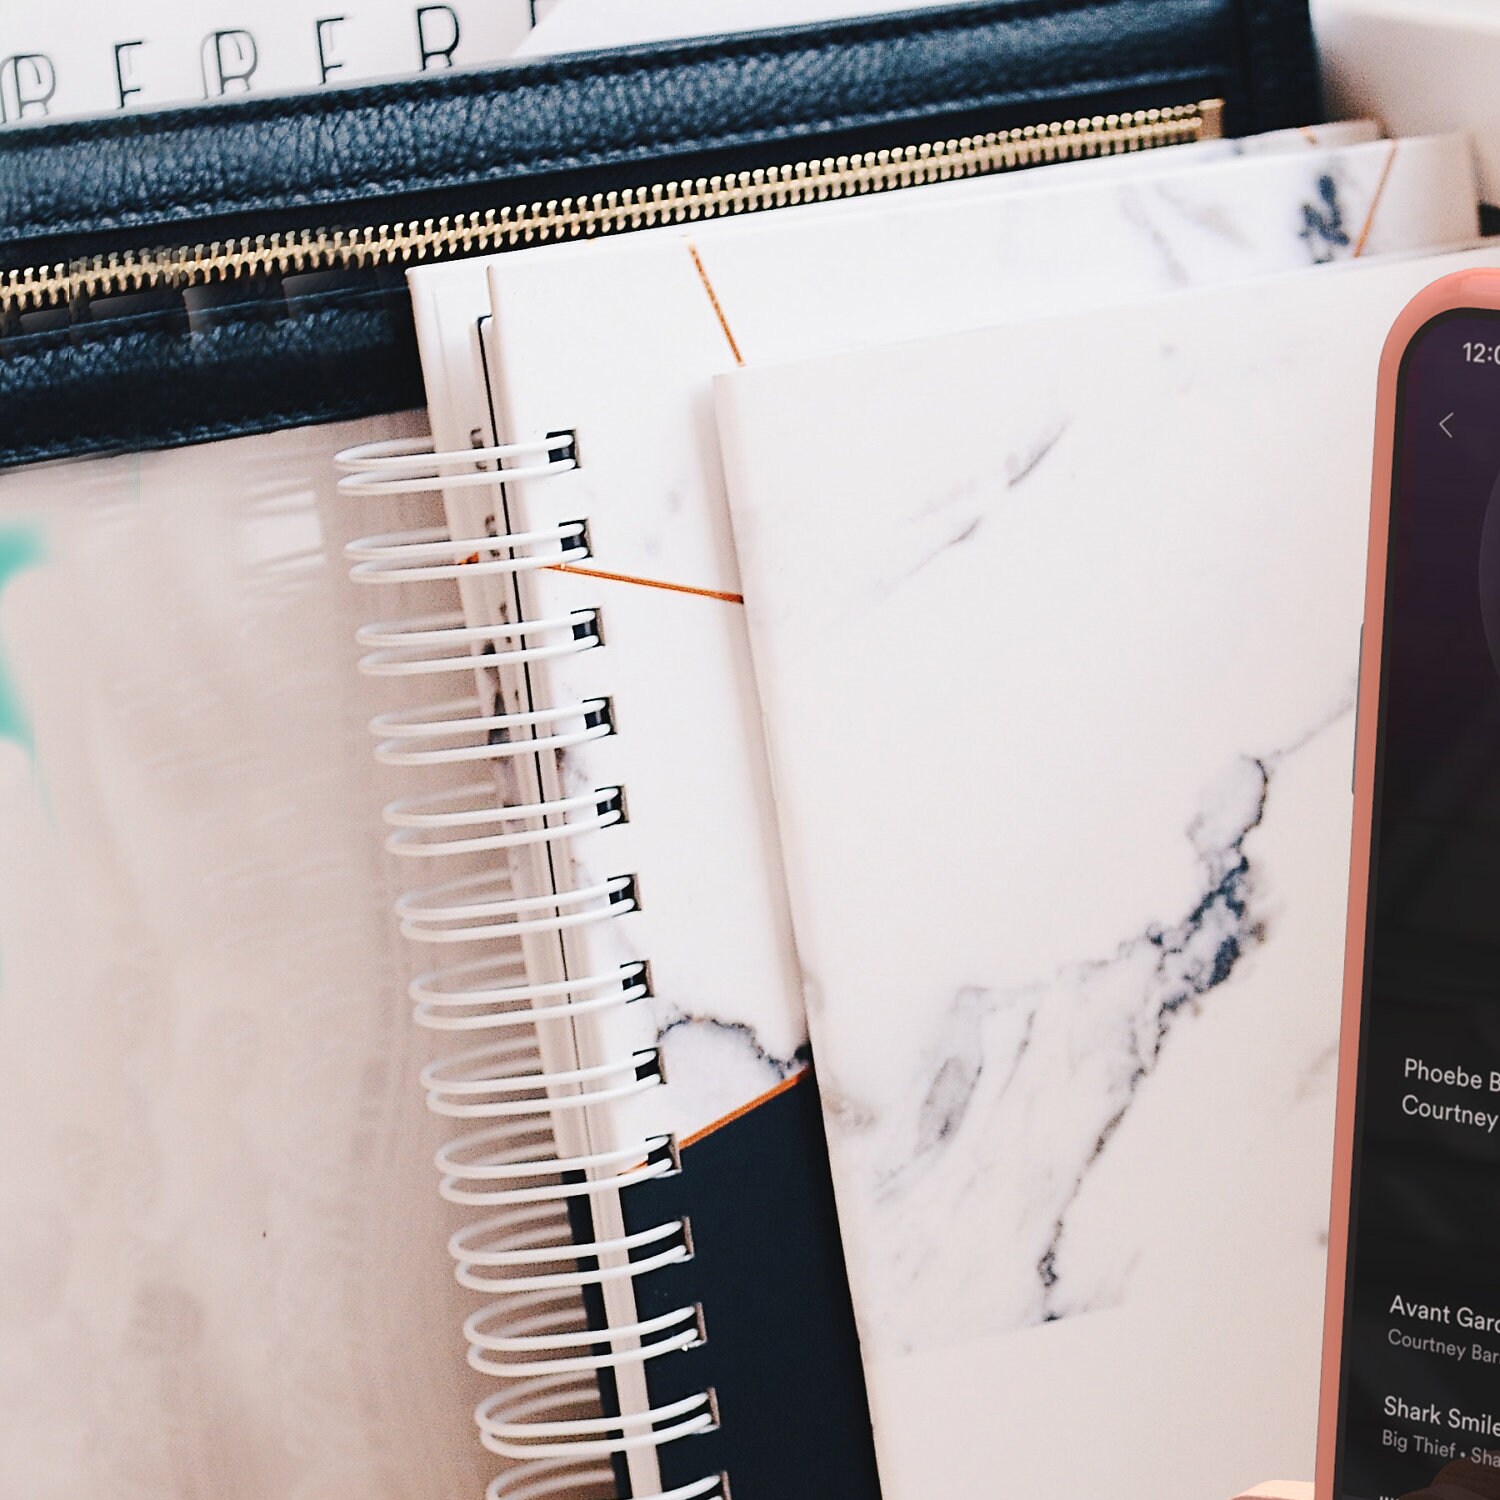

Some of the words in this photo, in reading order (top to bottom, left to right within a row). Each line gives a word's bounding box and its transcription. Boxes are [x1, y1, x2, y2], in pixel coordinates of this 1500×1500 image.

[1404, 1057, 1483, 1090] Phoebe
[1402, 1094, 1499, 1133] Courtney
[1389, 1294, 1451, 1324] Avant
[1388, 1328, 1467, 1361] Courtney
[1383, 1395, 1441, 1425] Shark
[1382, 1429, 1408, 1453] Big
[1413, 1434, 1456, 1459] Thief
